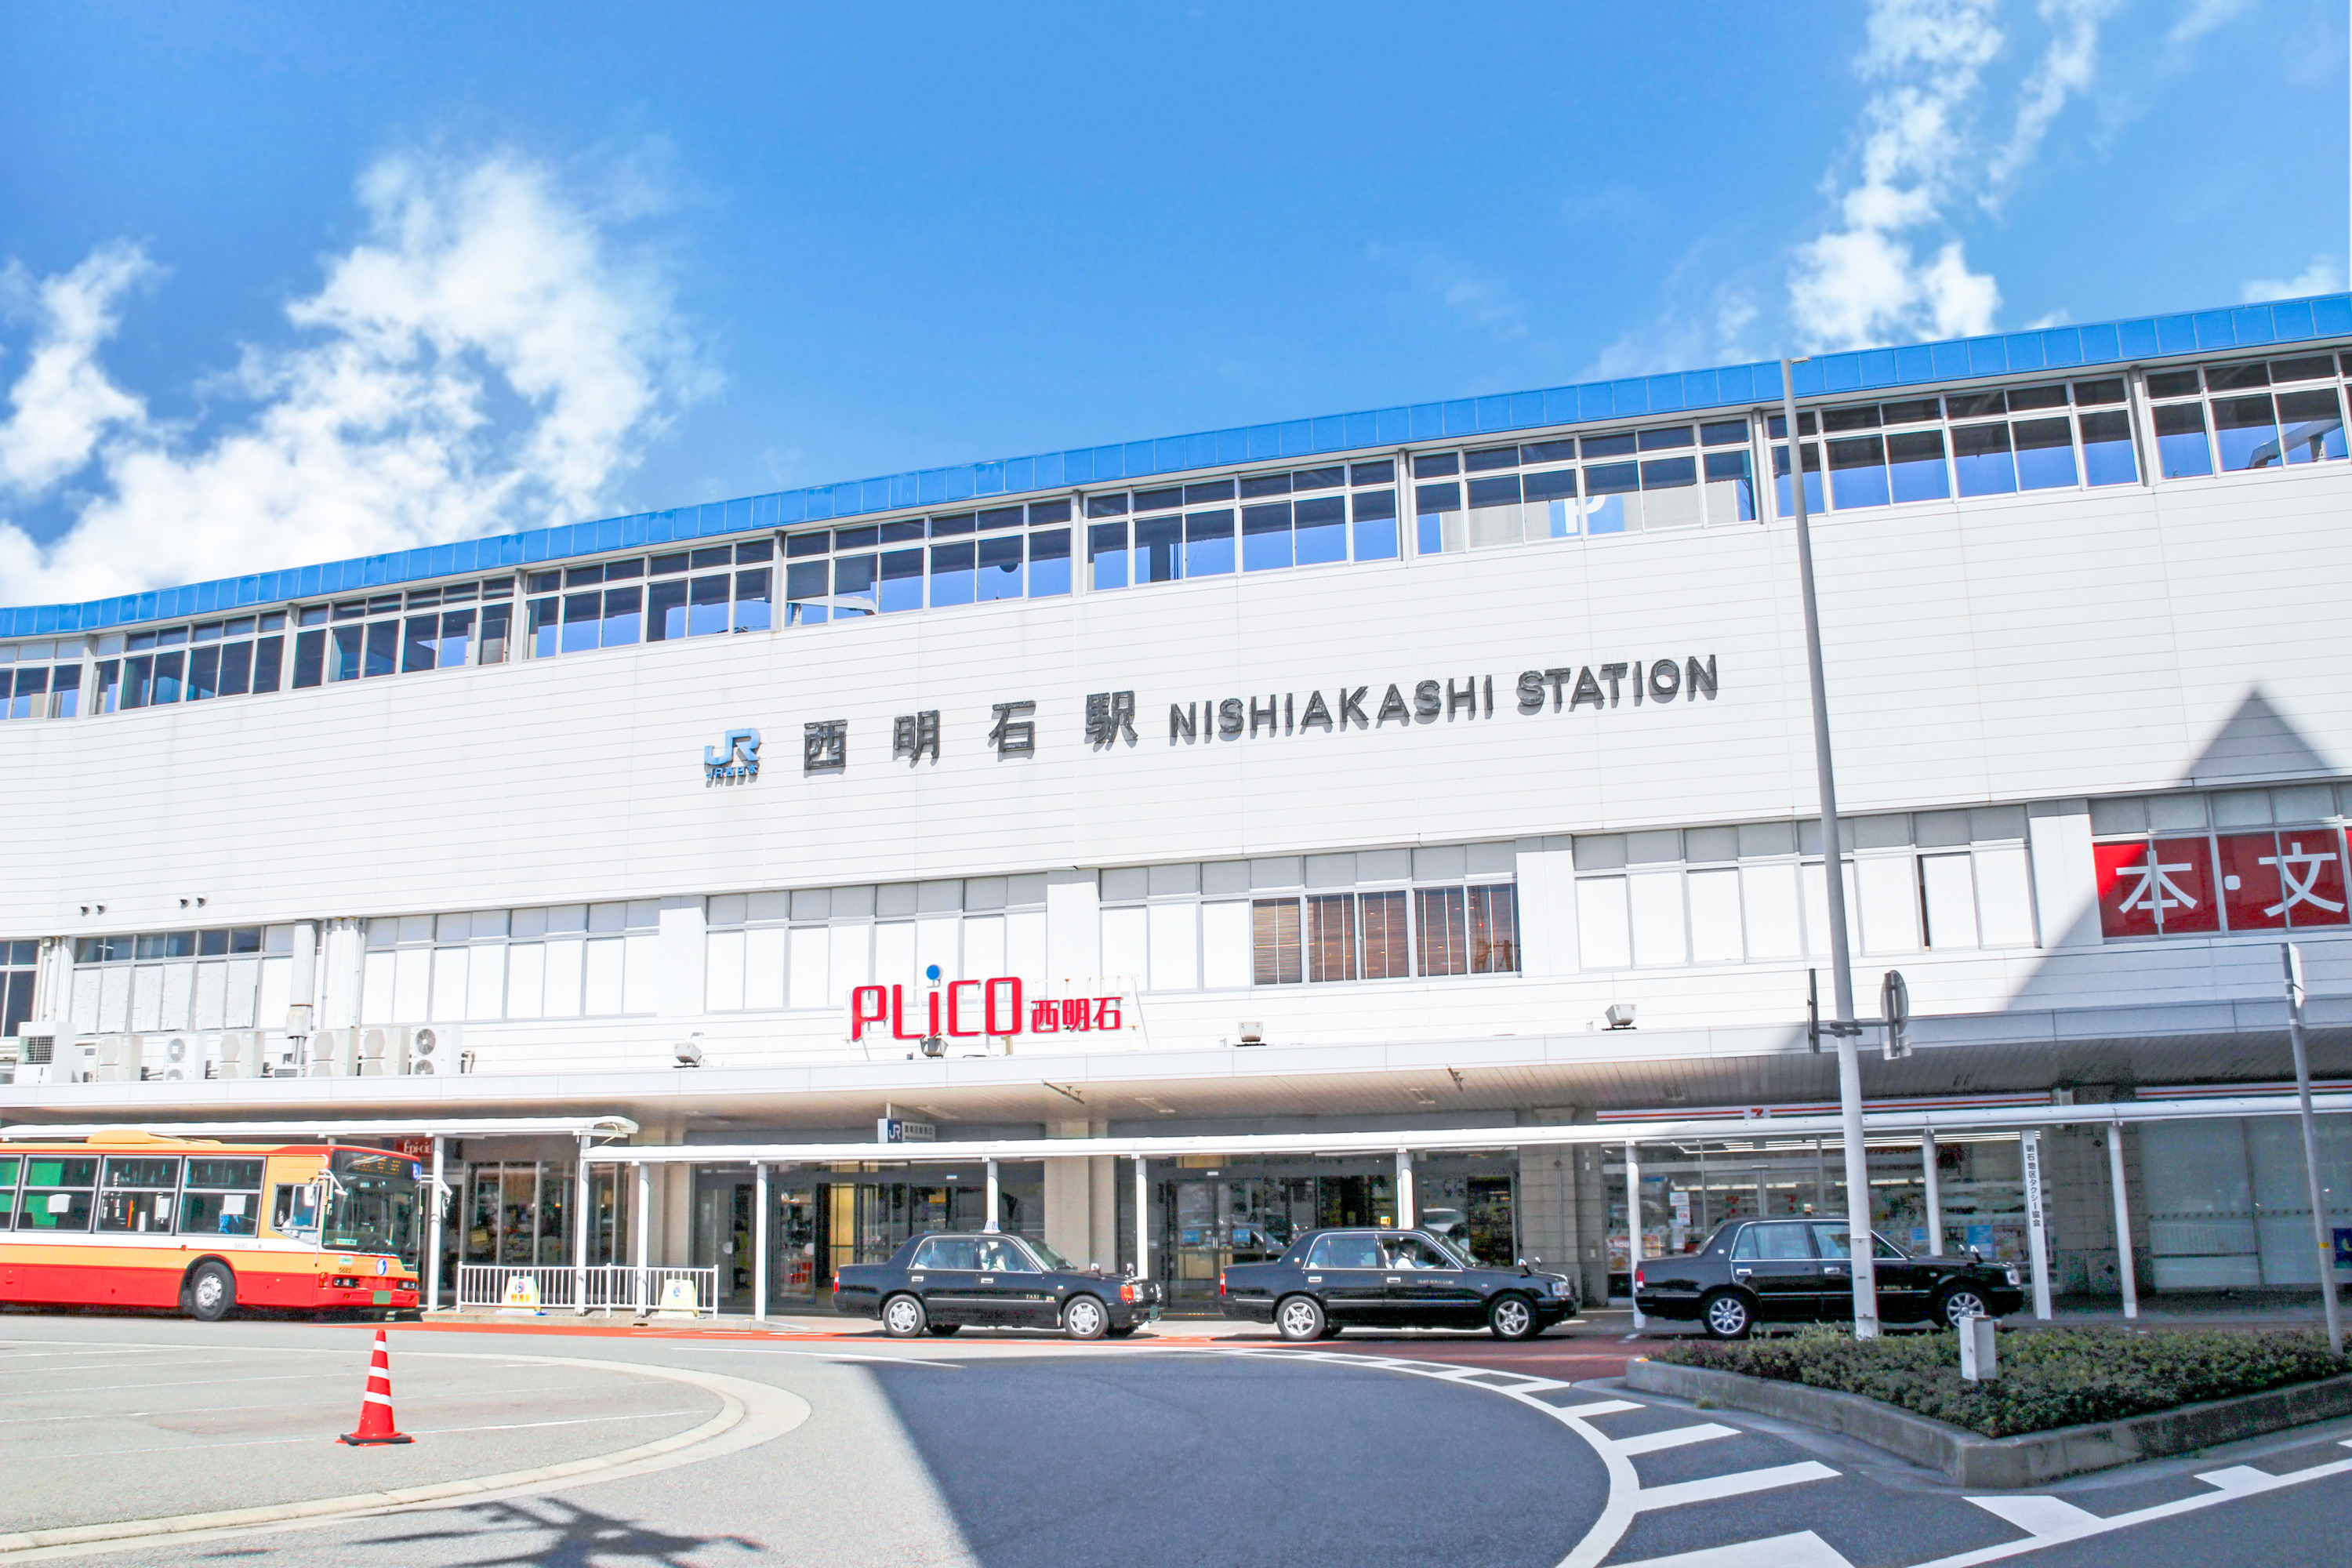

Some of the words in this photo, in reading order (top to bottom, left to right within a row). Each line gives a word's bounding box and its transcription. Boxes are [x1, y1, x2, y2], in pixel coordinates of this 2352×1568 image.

[1564, 494, 1606, 533] P
[1169, 673, 1494, 737] NISHIAKASHI
[1517, 654, 1718, 706] STATION
[704, 728, 760, 765] JR
[804, 690, 1138, 771] 西明石駅
[706, 764, 759, 779] JR西日本
[1031, 996, 1123, 1033] 西明石
[889, 1124, 901, 1139] JR
[2026, 1145, 2041, 1227] 明石地区タクシー協会
